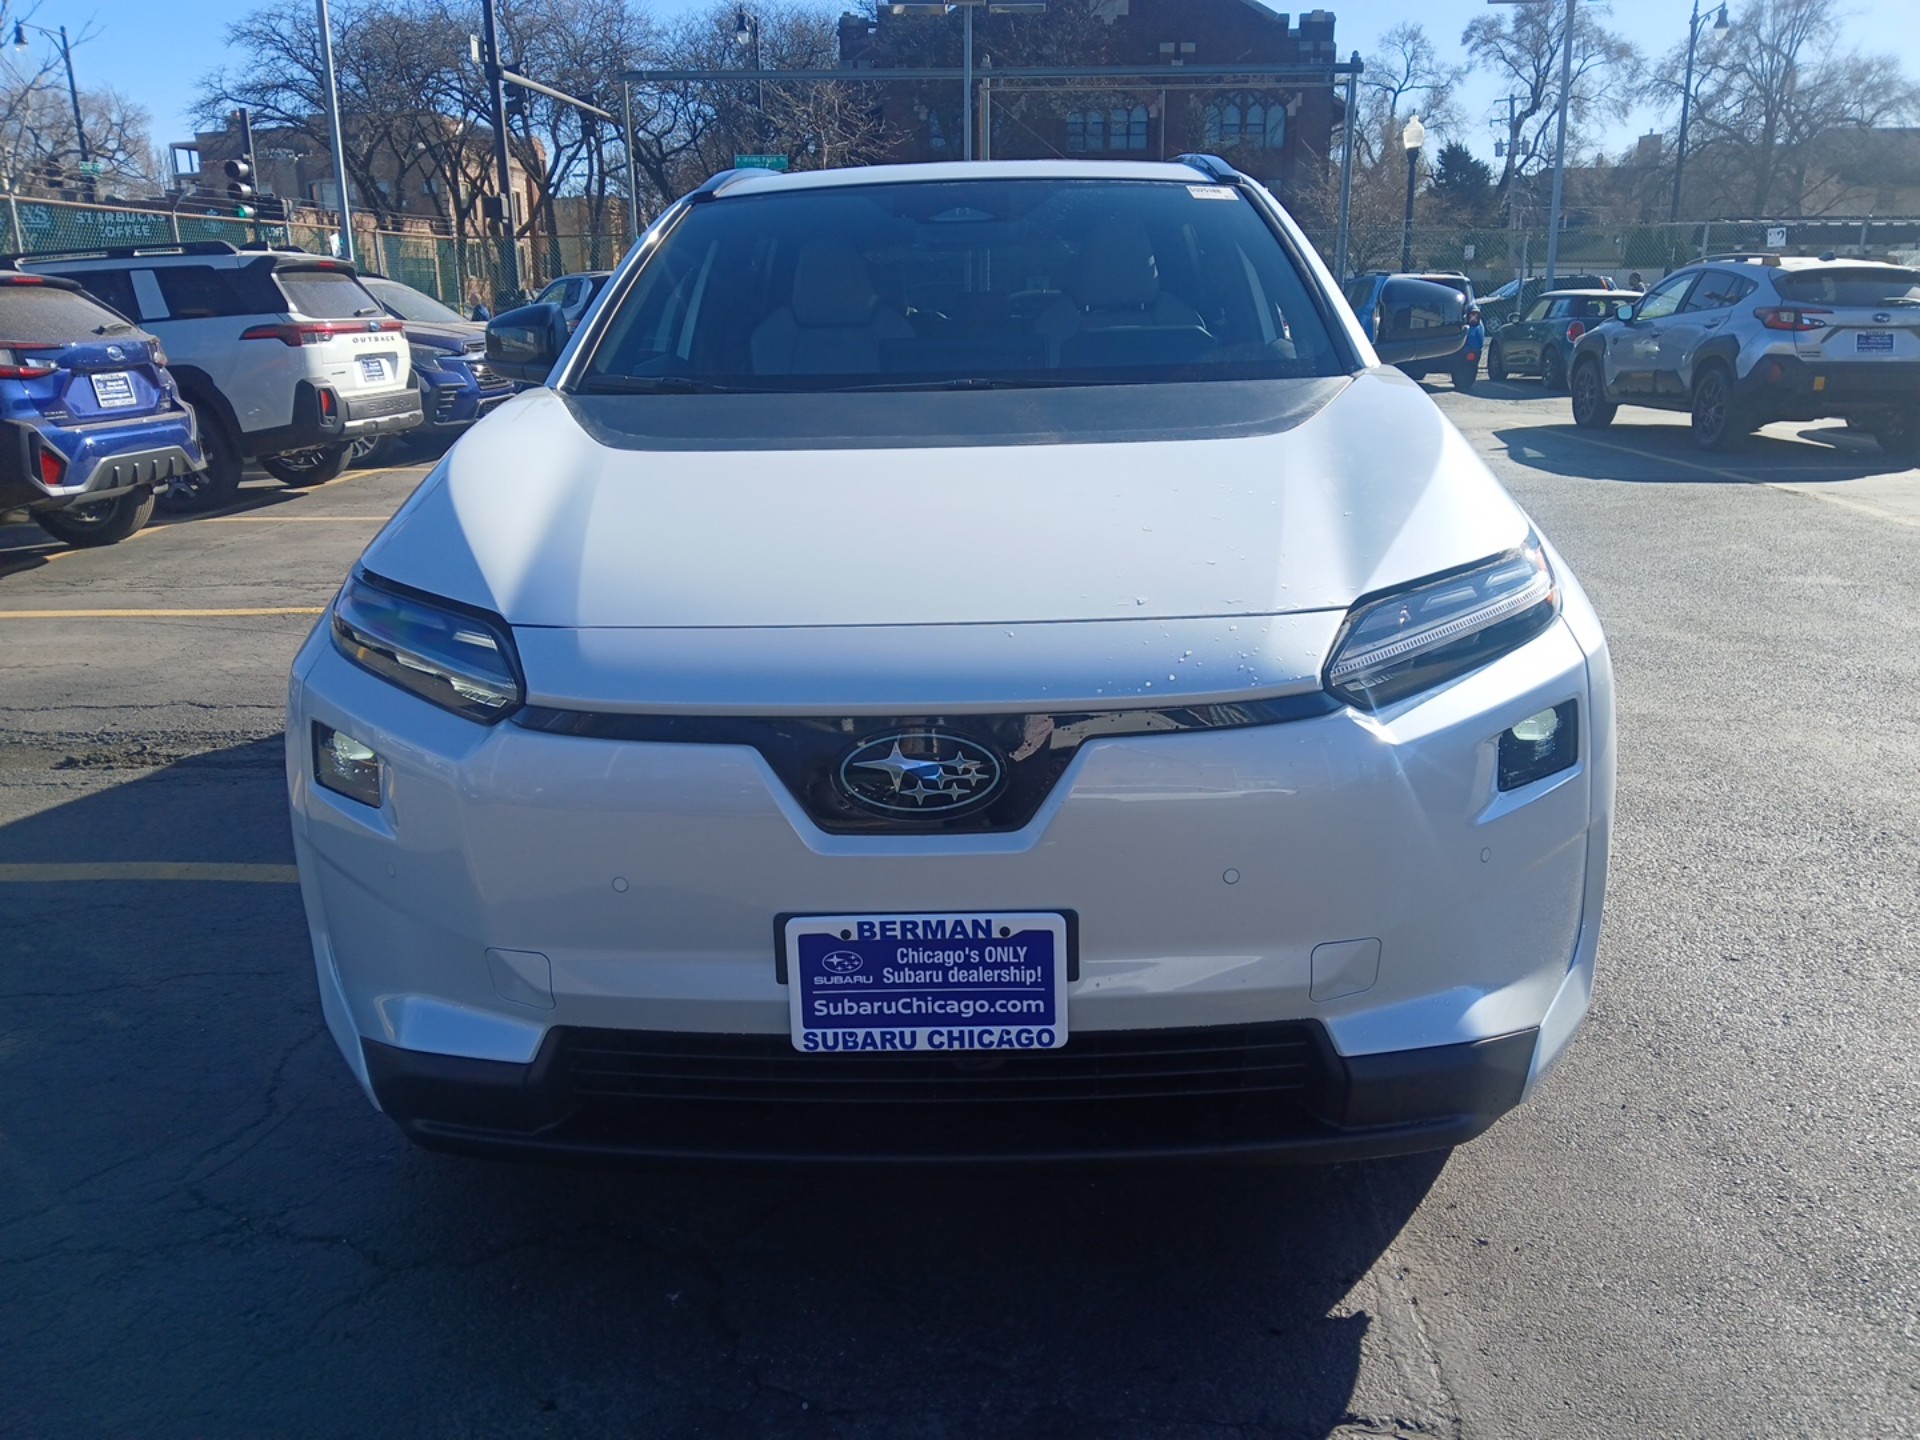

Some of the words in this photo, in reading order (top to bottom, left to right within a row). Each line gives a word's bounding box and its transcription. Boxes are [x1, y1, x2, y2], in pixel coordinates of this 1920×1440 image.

[352, 335, 396, 344] OUTBACK
[856, 918, 994, 940] BERMAN
[896, 947, 980, 966] Chicago's
[984, 945, 1028, 963] ONLY
[813, 975, 873, 985] SUBARU
[882, 967, 943, 984] Subaru
[947, 965, 1042, 986] dealership!
[813, 996, 1045, 1018] SubaruChicago.com
[803, 1030, 918, 1051] SUBARU
[926, 1028, 1056, 1050] CHICAGO
